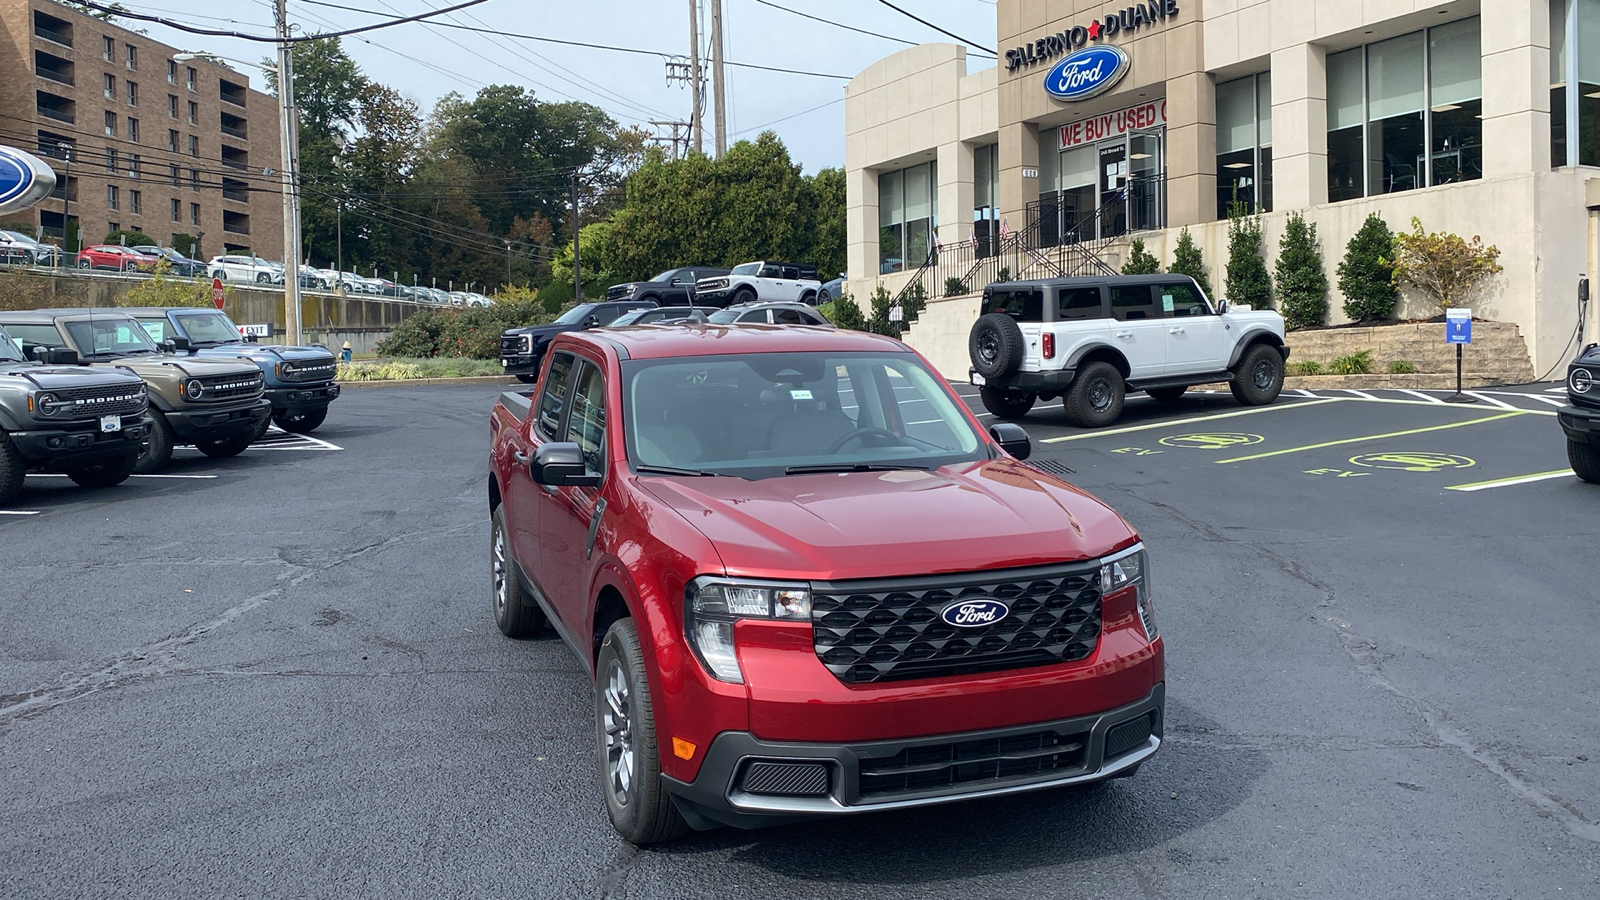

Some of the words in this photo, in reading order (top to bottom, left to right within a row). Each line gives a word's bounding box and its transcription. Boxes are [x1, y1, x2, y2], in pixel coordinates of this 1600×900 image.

[1004, 25, 1088, 70] SALERNO
[1104, 0, 1180, 36] DUANE
[1058, 57, 1104, 92] Ford
[1060, 123, 1081, 147] WE
[1085, 115, 1113, 141] BUY
[1117, 104, 1156, 133] USED
[213, 288, 223, 300] STOP
[246, 326, 264, 335] EXIT
[214, 381, 255, 390] BRONCO
[75, 395, 132, 405] BRONCO
[1110, 447, 1164, 456] EV
[1302, 468, 1373, 477] EV
[955, 604, 997, 623] Ford
